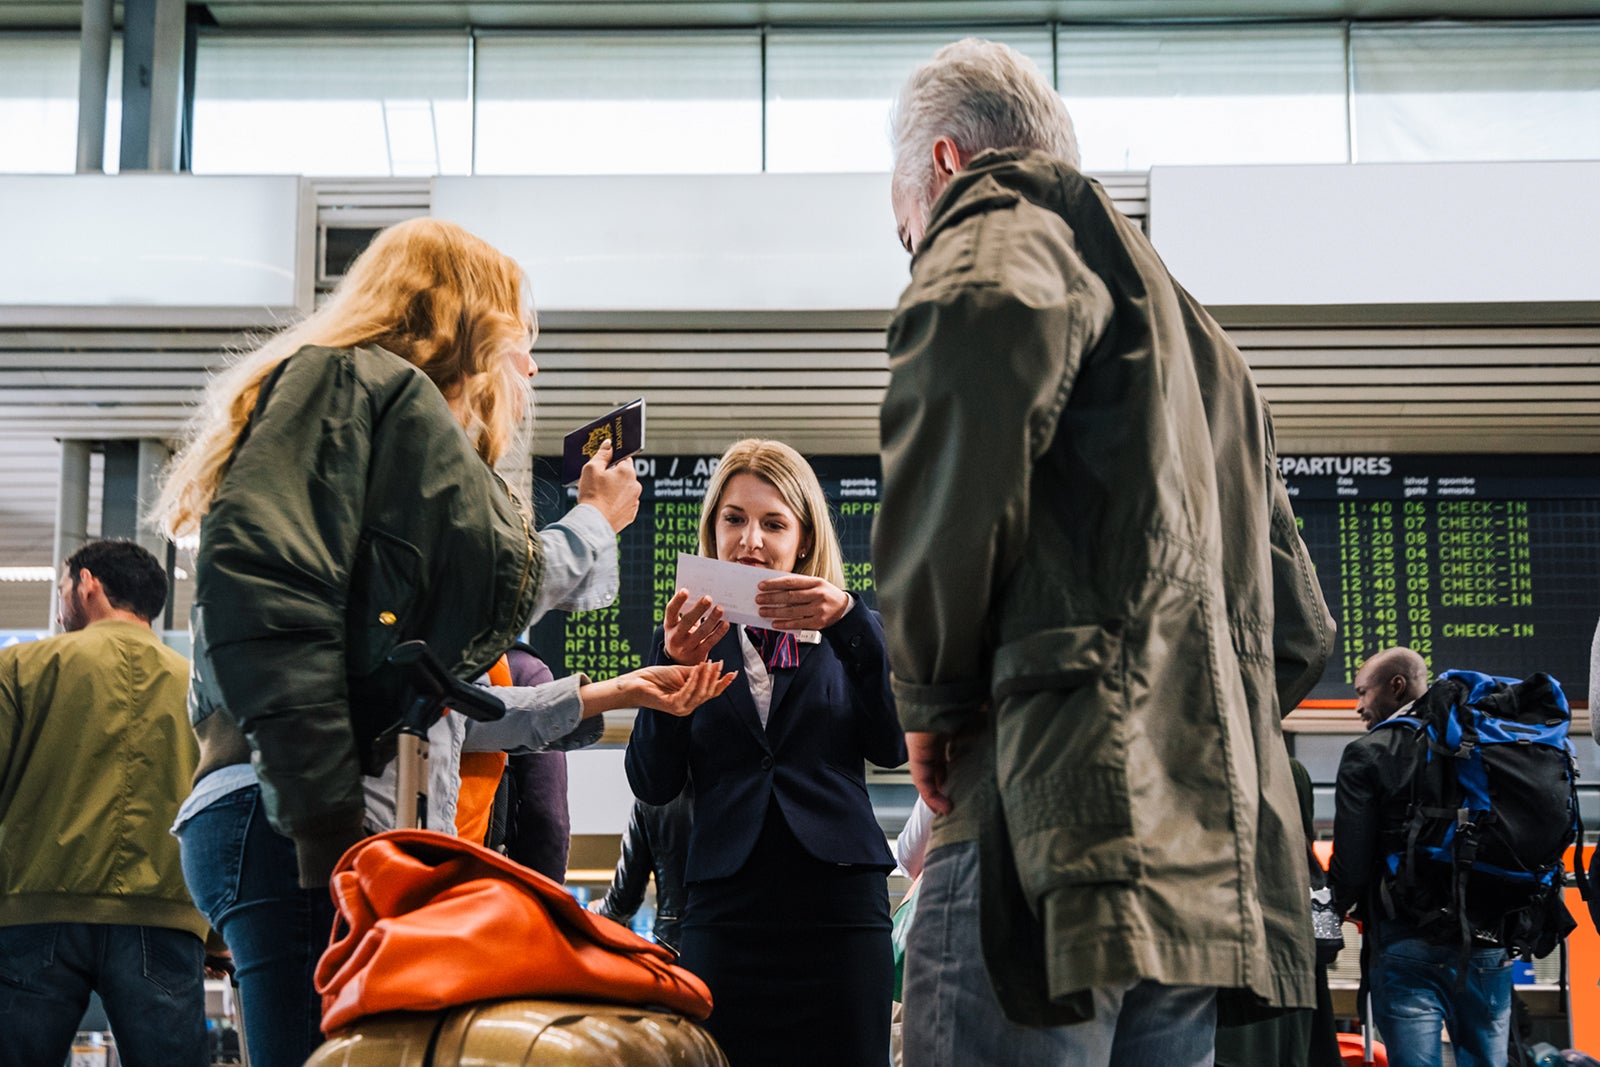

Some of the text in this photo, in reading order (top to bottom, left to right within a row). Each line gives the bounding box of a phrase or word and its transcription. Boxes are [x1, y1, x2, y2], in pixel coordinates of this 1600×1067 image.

[655, 502, 703, 515] FRAN
[1404, 502, 1425, 515] 06
[1438, 502, 1527, 515] CHECK-IN
[1404, 517, 1426, 530] 07
[1438, 517, 1528, 530] CHECK-IN
[1405, 532, 1427, 545] 08
[1439, 532, 1529, 545] CHECK-IN
[1405, 547, 1428, 560] 04
[1439, 547, 1530, 560] CHECK-IN
[1406, 563, 1429, 576] 03
[1440, 563, 1530, 576] CHECK-IN
[1407, 578, 1429, 591] 05
[1441, 578, 1531, 591] CHECK-IN
[1407, 593, 1428, 606] 01
[1441, 593, 1532, 606] CHECK-IN
[566, 609, 620, 622] JP377
[1408, 608, 1431, 621] 02
[1411, 624, 1432, 637] 10
[1442, 624, 1534, 637] CHECK-IN
[565, 639, 630, 652] AF1186
[1409, 639, 1432, 652] 02
[565, 655, 641, 668] EZY3245
[570, 670, 619, 682] 705
